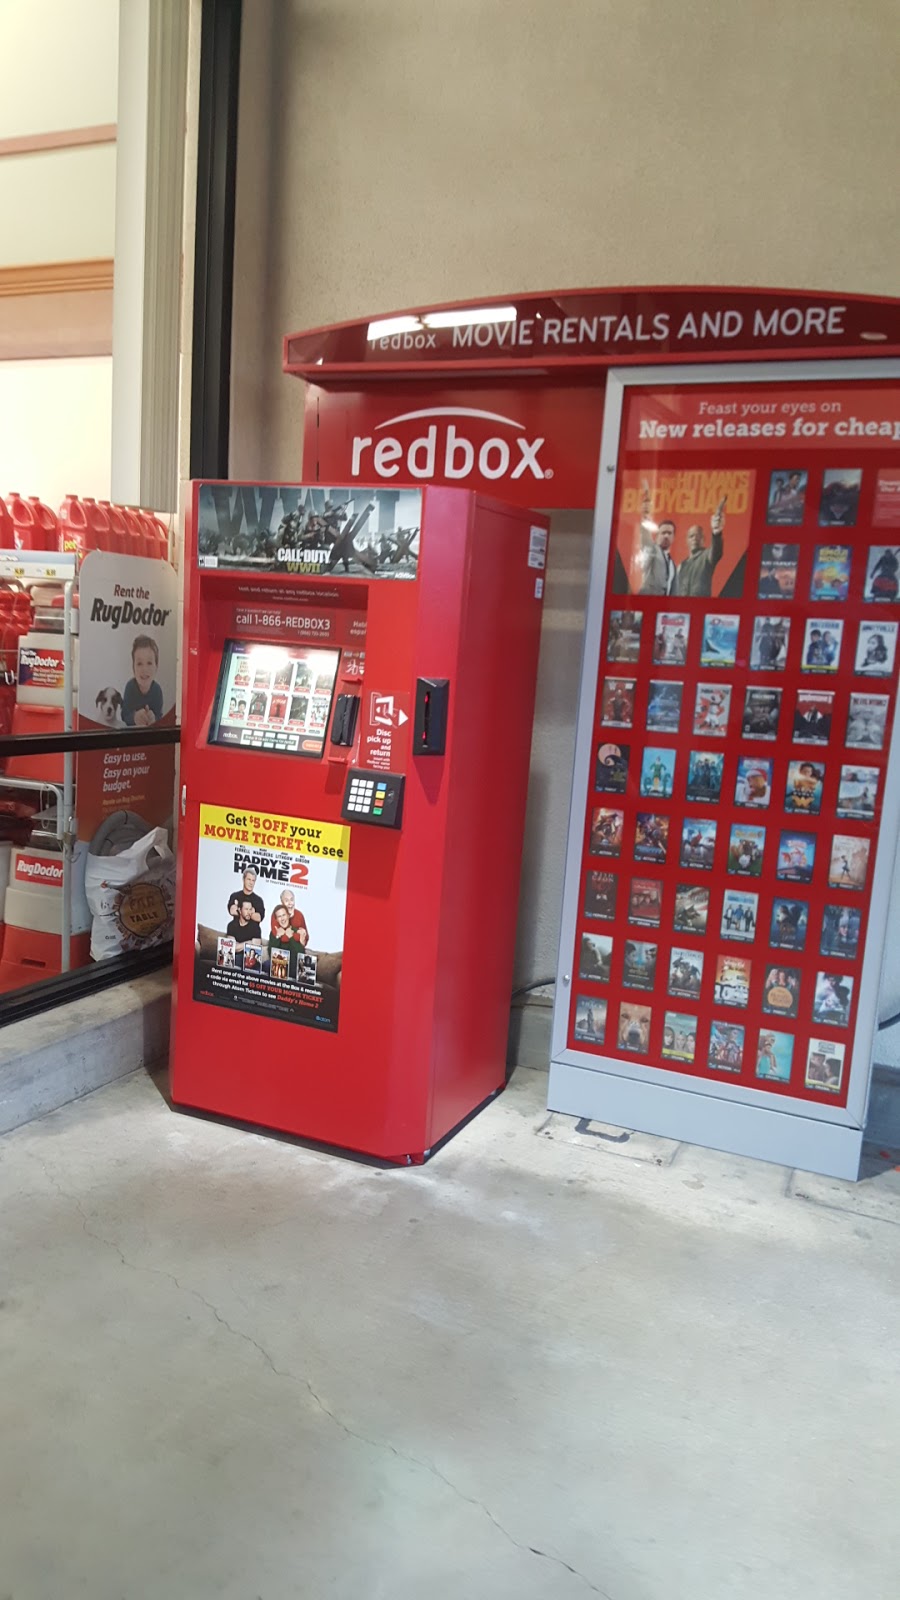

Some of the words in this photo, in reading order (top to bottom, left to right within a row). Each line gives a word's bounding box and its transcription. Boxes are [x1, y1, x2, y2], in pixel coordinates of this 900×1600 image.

[453, 319, 534, 348] MOVIE
[543, 314, 669, 343] RENTALS
[677, 311, 743, 340] AND
[753, 306, 846, 336] MORE
[699, 401, 737, 415] Feast
[742, 403, 777, 417] your
[781, 402, 816, 417] eyes
[820, 401, 842, 412] on
[639, 420, 688, 438] New
[692, 420, 786, 438] releases
[792, 417, 829, 437] for
[351, 425, 545, 479] redbox
[278, 548, 300, 562] CALL
[304, 549, 331, 564] DUTY
[287, 562, 320, 573] WWII
[114, 584, 134, 599] Rent
[135, 587, 150, 599] the
[90, 598, 169, 629] RugDoctor
[236, 614, 252, 625] call
[255, 614, 331, 630] 1-866-REDBOX3
[367, 735, 381, 743] pick
[376, 728, 391, 737] Disc
[104, 753, 121, 765] Easy
[123, 753, 130, 762] to
[132, 752, 146, 761] use.
[370, 749, 390, 757] return
[103, 768, 121, 779] Easy
[122, 767, 131, 776] on
[133, 766, 150, 778] your
[103, 780, 131, 792] budget.
[226, 813, 247, 827] Get
[249, 815, 260, 829] $5
[262, 818, 288, 833] OFF
[290, 825, 322, 839] your
[204, 823, 249, 842] MOVIE
[252, 832, 303, 851] TICKET
[307, 842, 319, 853] to
[323, 846, 344, 858] see
[17, 860, 64, 878] RugDoctor
[234, 853, 290, 870] DADDY'S
[233, 861, 289, 882] HOME
[290, 863, 309, 886] 2
[210, 973, 221, 981] code
[229, 977, 241, 985] email
[267, 985, 282, 994] YOUR
[283, 988, 302, 998] MOVIE
[302, 993, 324, 1003] TICKET
[246, 974, 259, 982] above
[260, 978, 276, 986] movies
[304, 987, 321, 995] receive
[212, 981, 231, 990] through
[245, 987, 261, 996] Tickets
[277, 993, 298, 1006] Daddy's
[299, 1000, 315, 1008] Home
